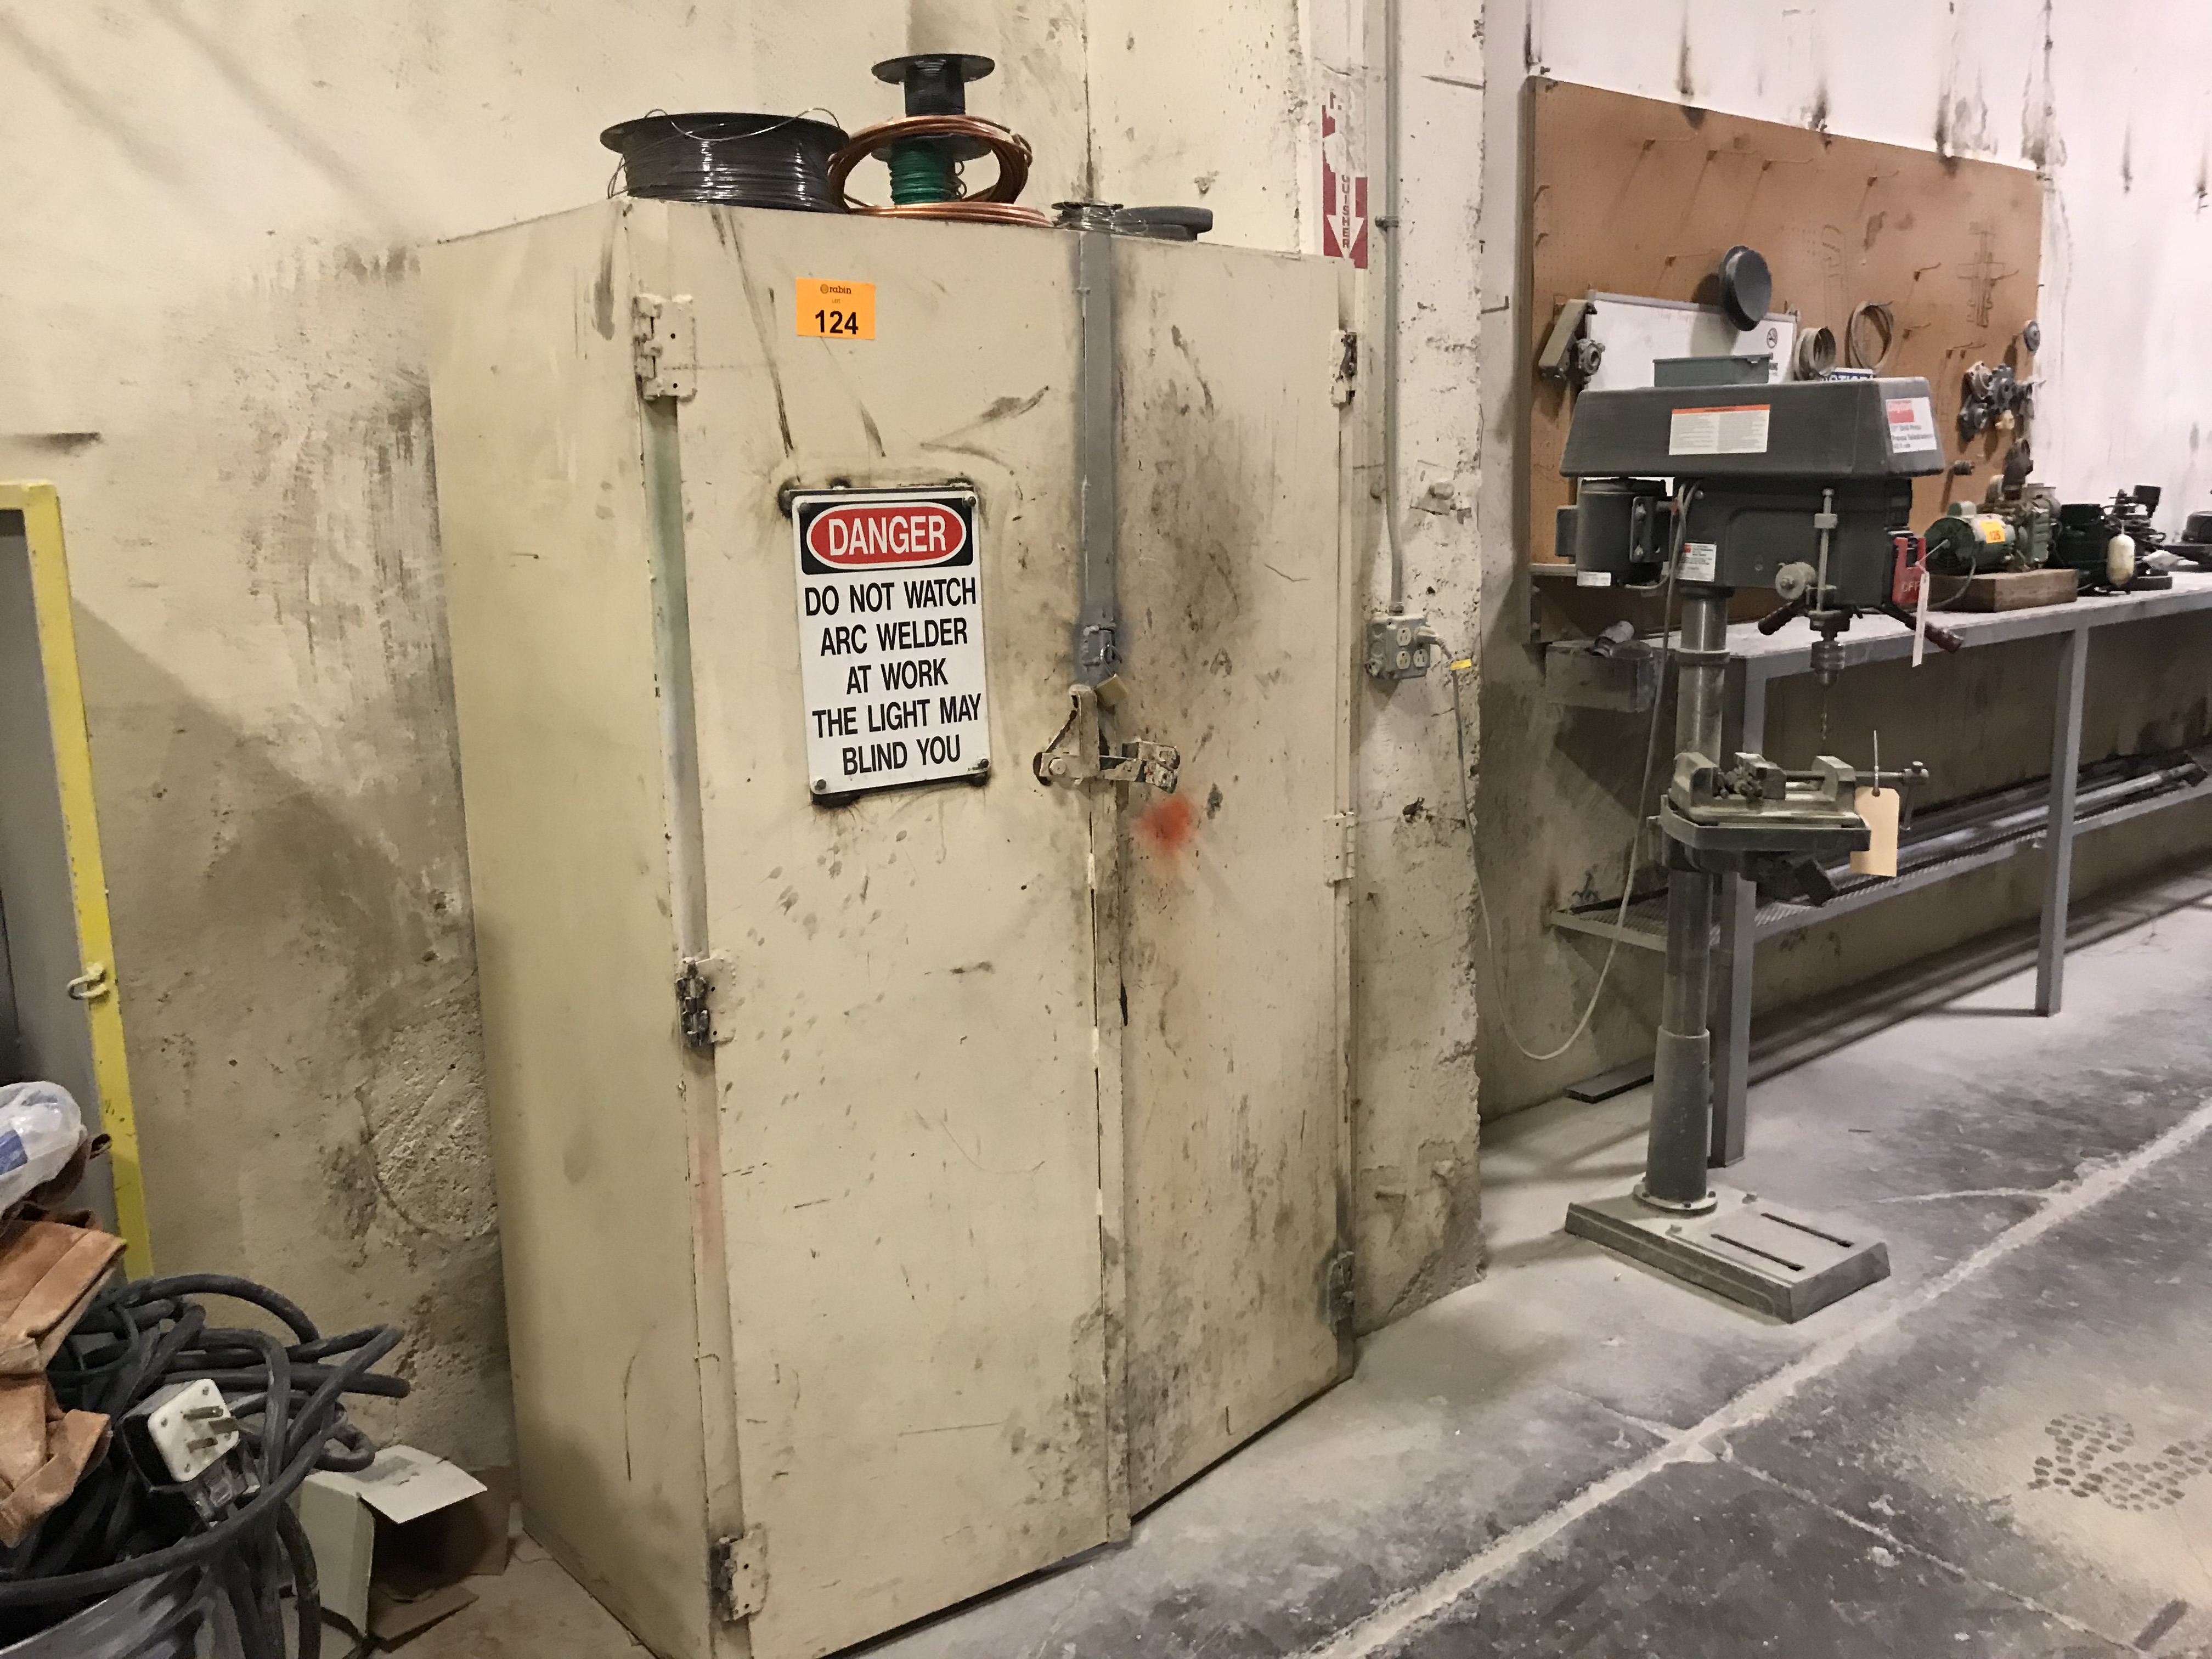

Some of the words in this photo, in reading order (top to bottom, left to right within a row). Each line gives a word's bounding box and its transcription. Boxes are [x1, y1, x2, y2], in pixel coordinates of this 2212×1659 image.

[829, 286, 851, 294] rabin
[815, 310, 859, 335] 124
[828, 515, 946, 556] DANGER
[805, 585, 839, 616] DO
[850, 582, 895, 613] NOT
[904, 577, 976, 609] WATCH
[821, 624, 867, 656] ARC
[876, 617, 968, 651] WELDER
[847, 665, 872, 695] AT
[881, 658, 949, 691] WORK
[812, 707, 858, 738] THE
[868, 698, 930, 732] LIGHT
[939, 693, 981, 724] MAY
[842, 741, 908, 776] BLIND
[916, 734, 961, 766] YOU
